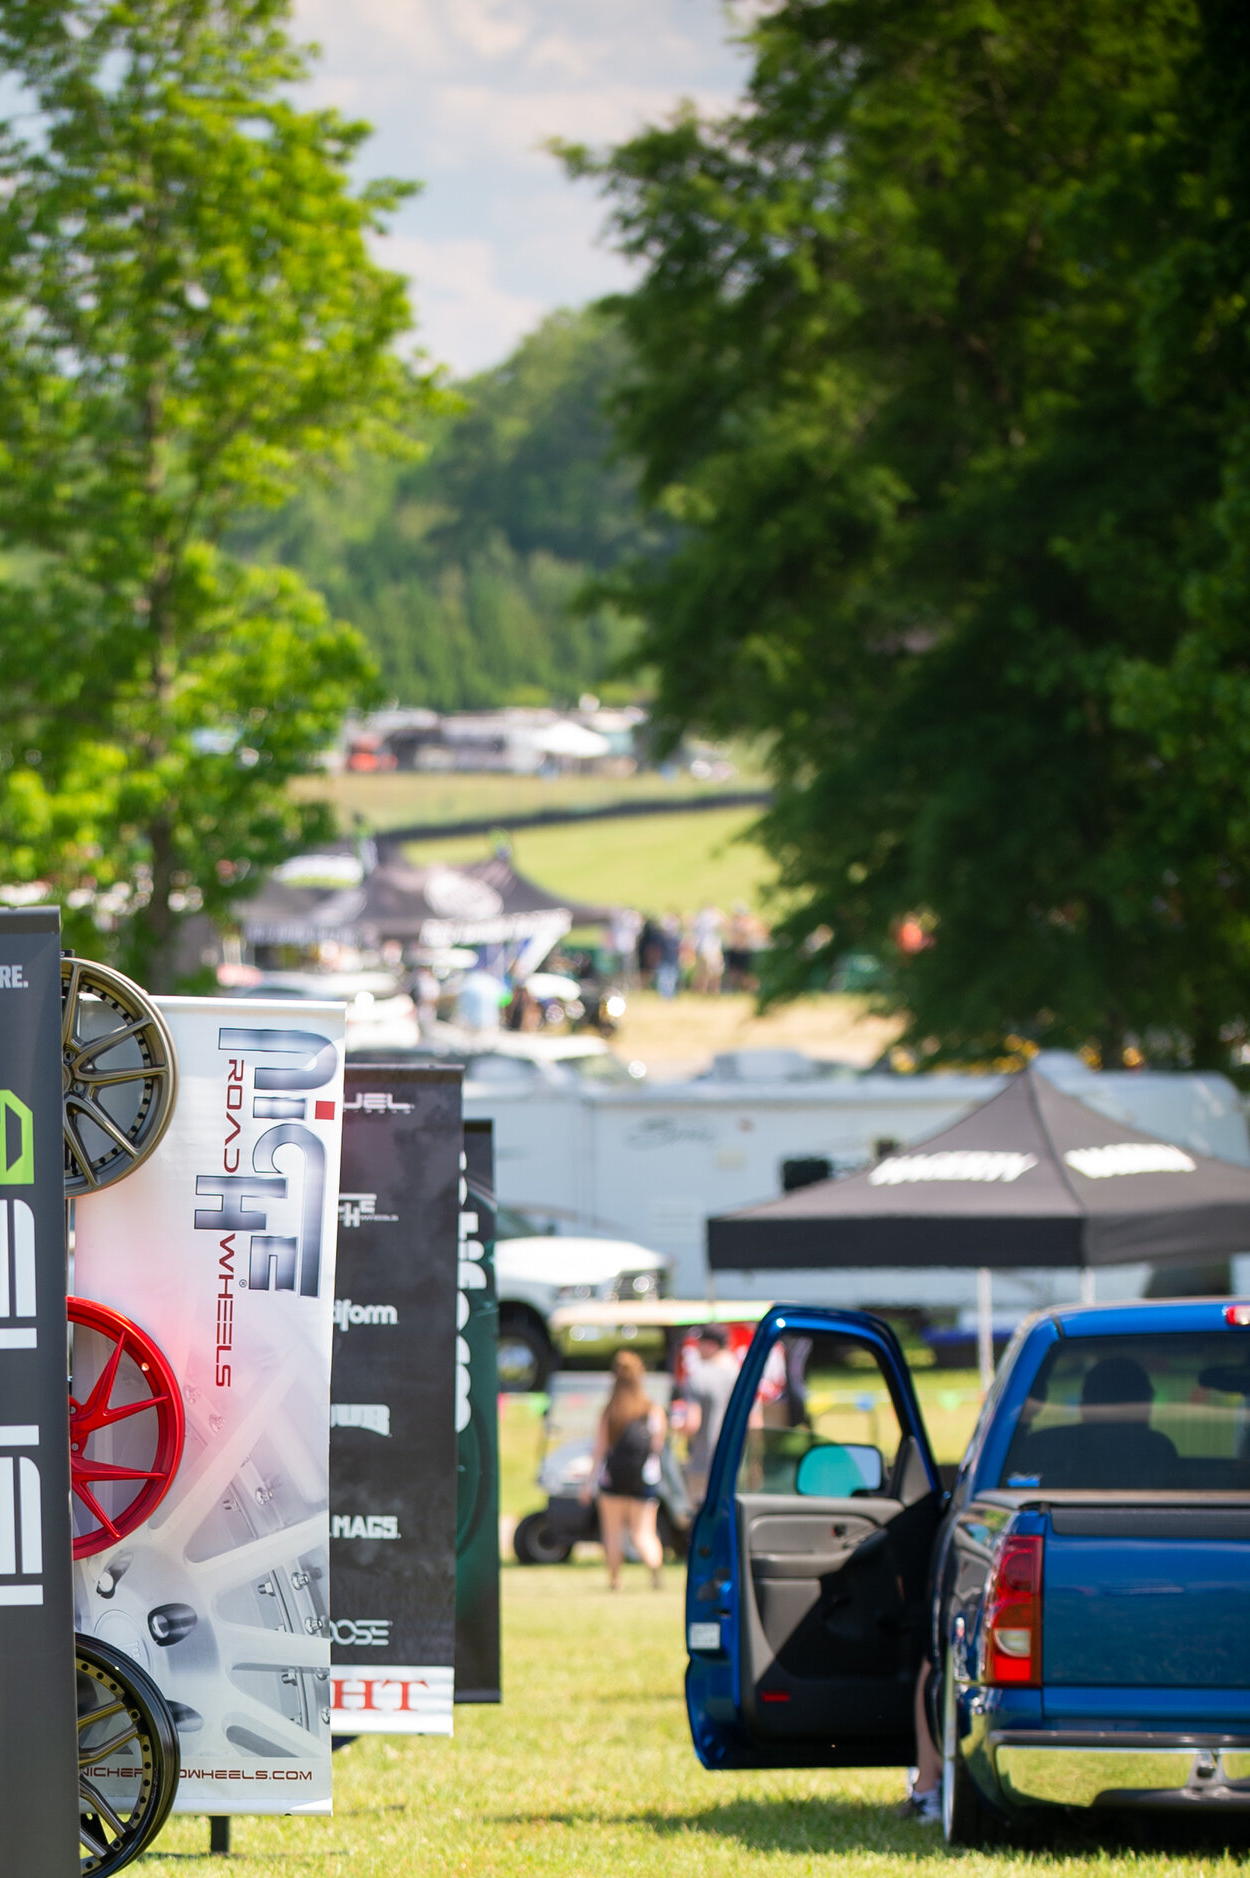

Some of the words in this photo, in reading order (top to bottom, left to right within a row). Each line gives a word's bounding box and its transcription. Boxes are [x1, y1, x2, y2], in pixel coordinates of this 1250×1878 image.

[222, 1058, 245, 1174] ROAD
[343, 1092, 411, 1110] UEL
[213, 1232, 236, 1388] WHEELS
[334, 1298, 399, 1333] iform
[330, 1619, 390, 1646] OSE
[330, 1678, 430, 1712] HT
